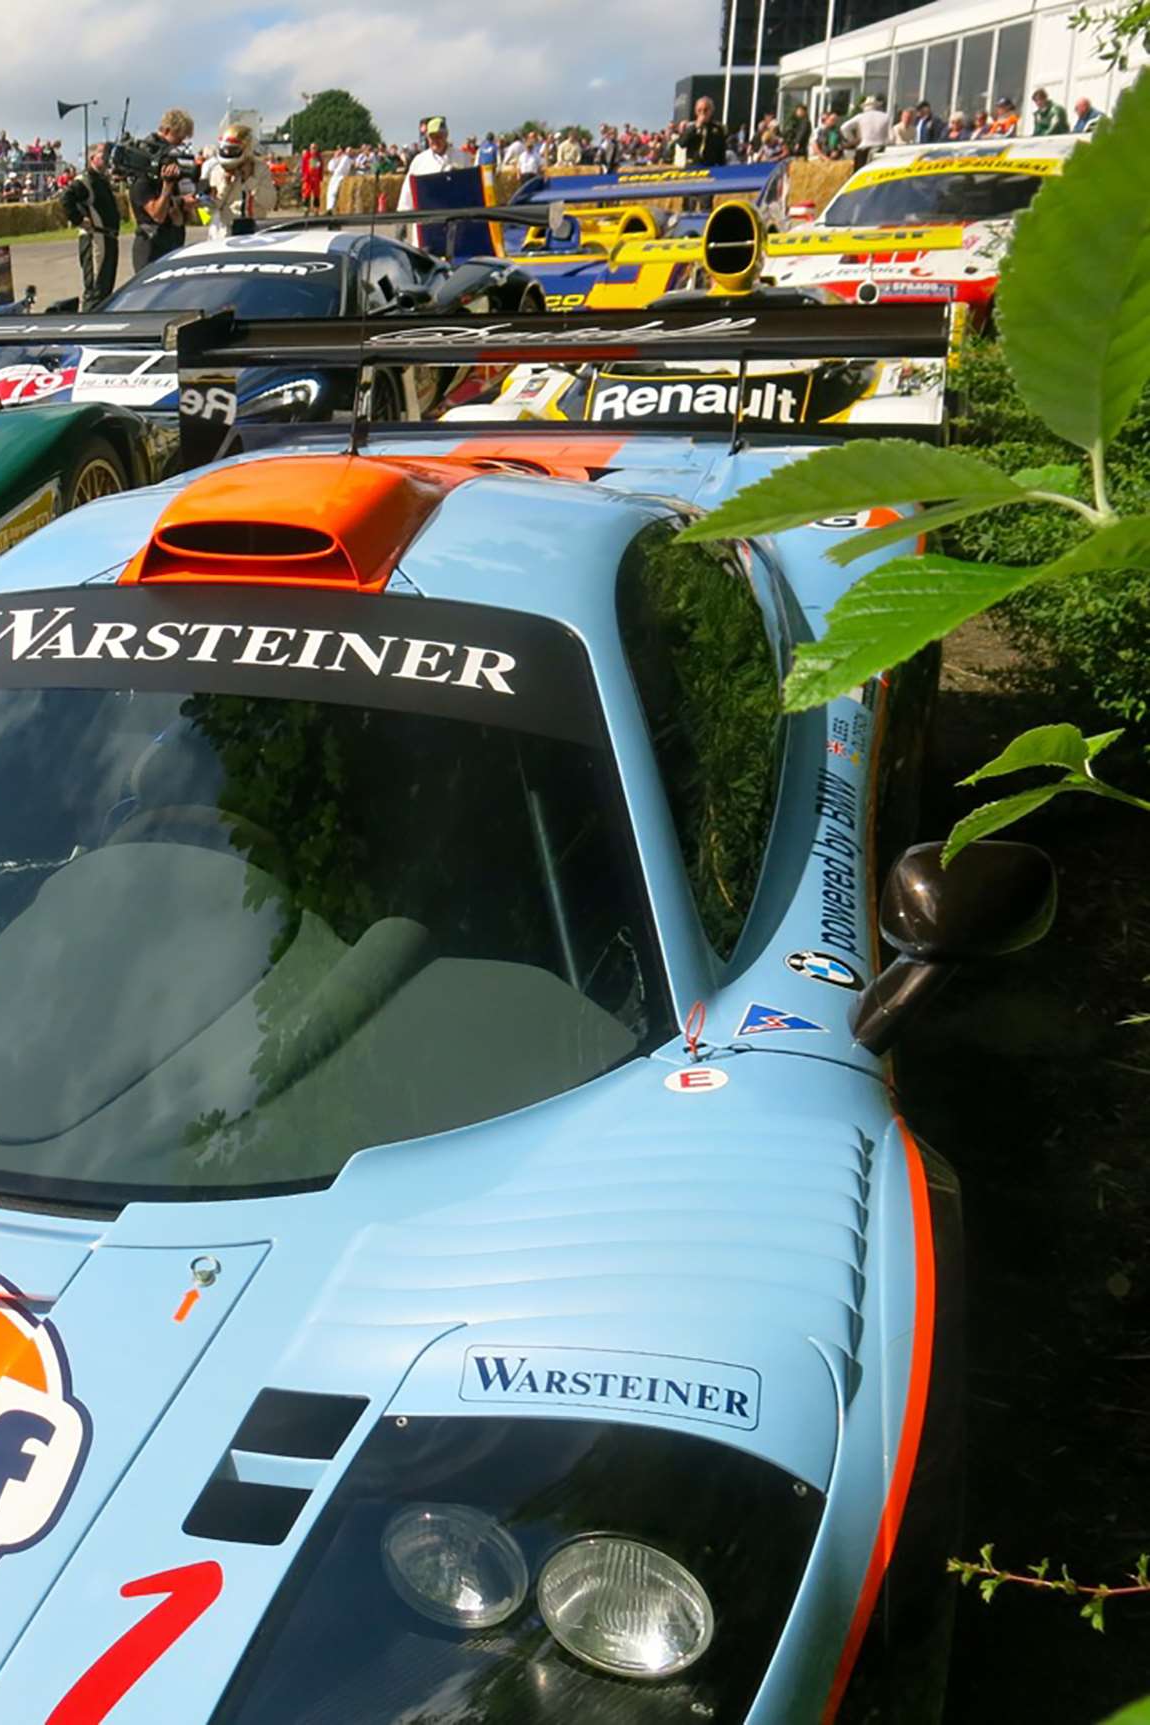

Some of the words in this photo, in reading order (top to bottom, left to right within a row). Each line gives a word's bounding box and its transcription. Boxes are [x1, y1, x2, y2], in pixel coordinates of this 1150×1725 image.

[6, 373, 64, 400] 79
[591, 382, 797, 423] Renault
[815, 767, 857, 832] BMW
[811, 824, 862, 858] by
[812, 853, 865, 962] powered
[473, 1355, 751, 1418] WARSTEINER
